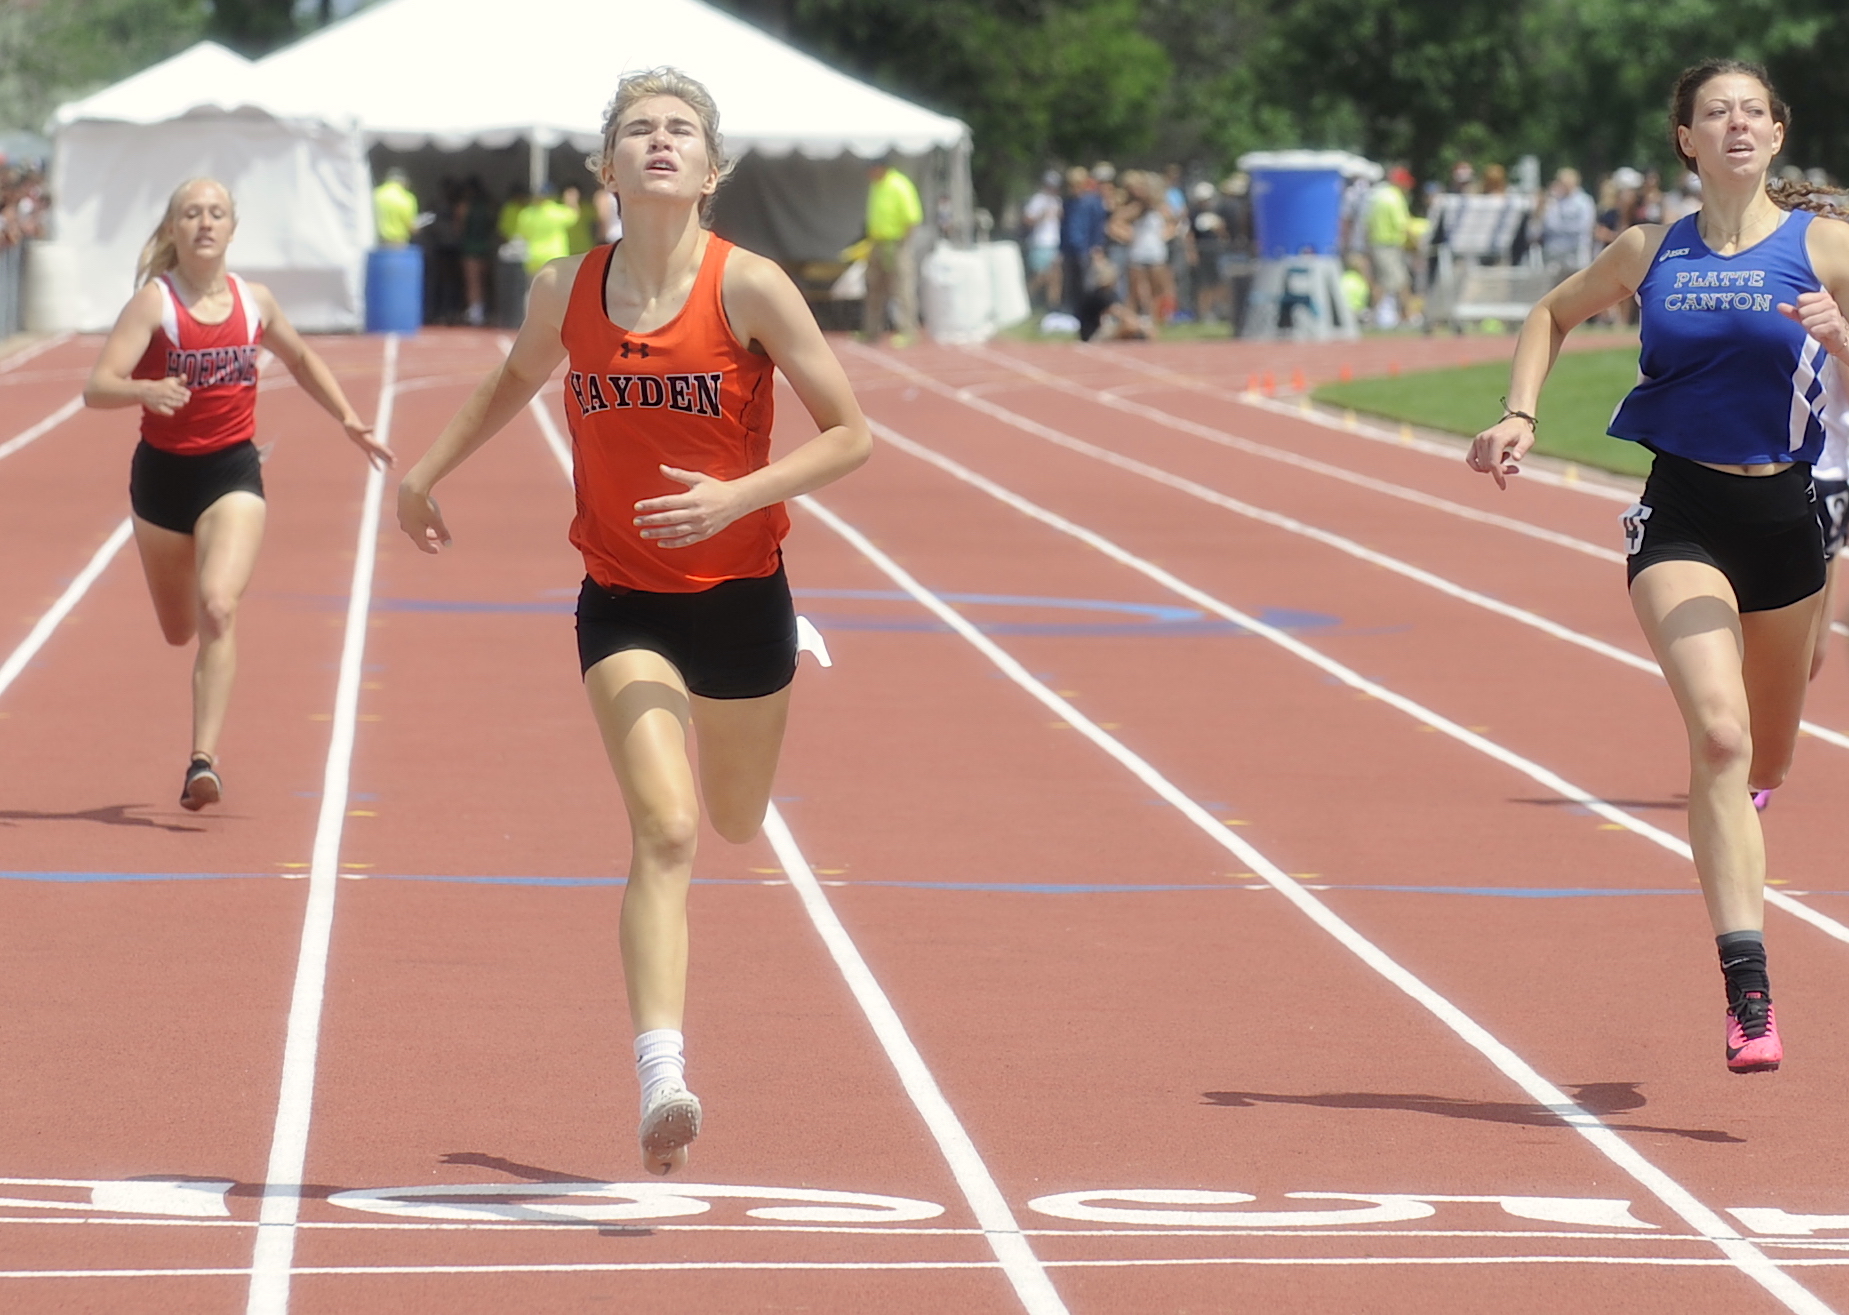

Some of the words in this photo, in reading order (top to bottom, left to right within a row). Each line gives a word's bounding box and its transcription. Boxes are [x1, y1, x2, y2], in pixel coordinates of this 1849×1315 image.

[1674, 270, 1765, 288] PLATTE
[1665, 293, 1772, 311] CANYON
[570, 371, 722, 418] HAYDEN
[1027, 1189, 1661, 1228] 5
